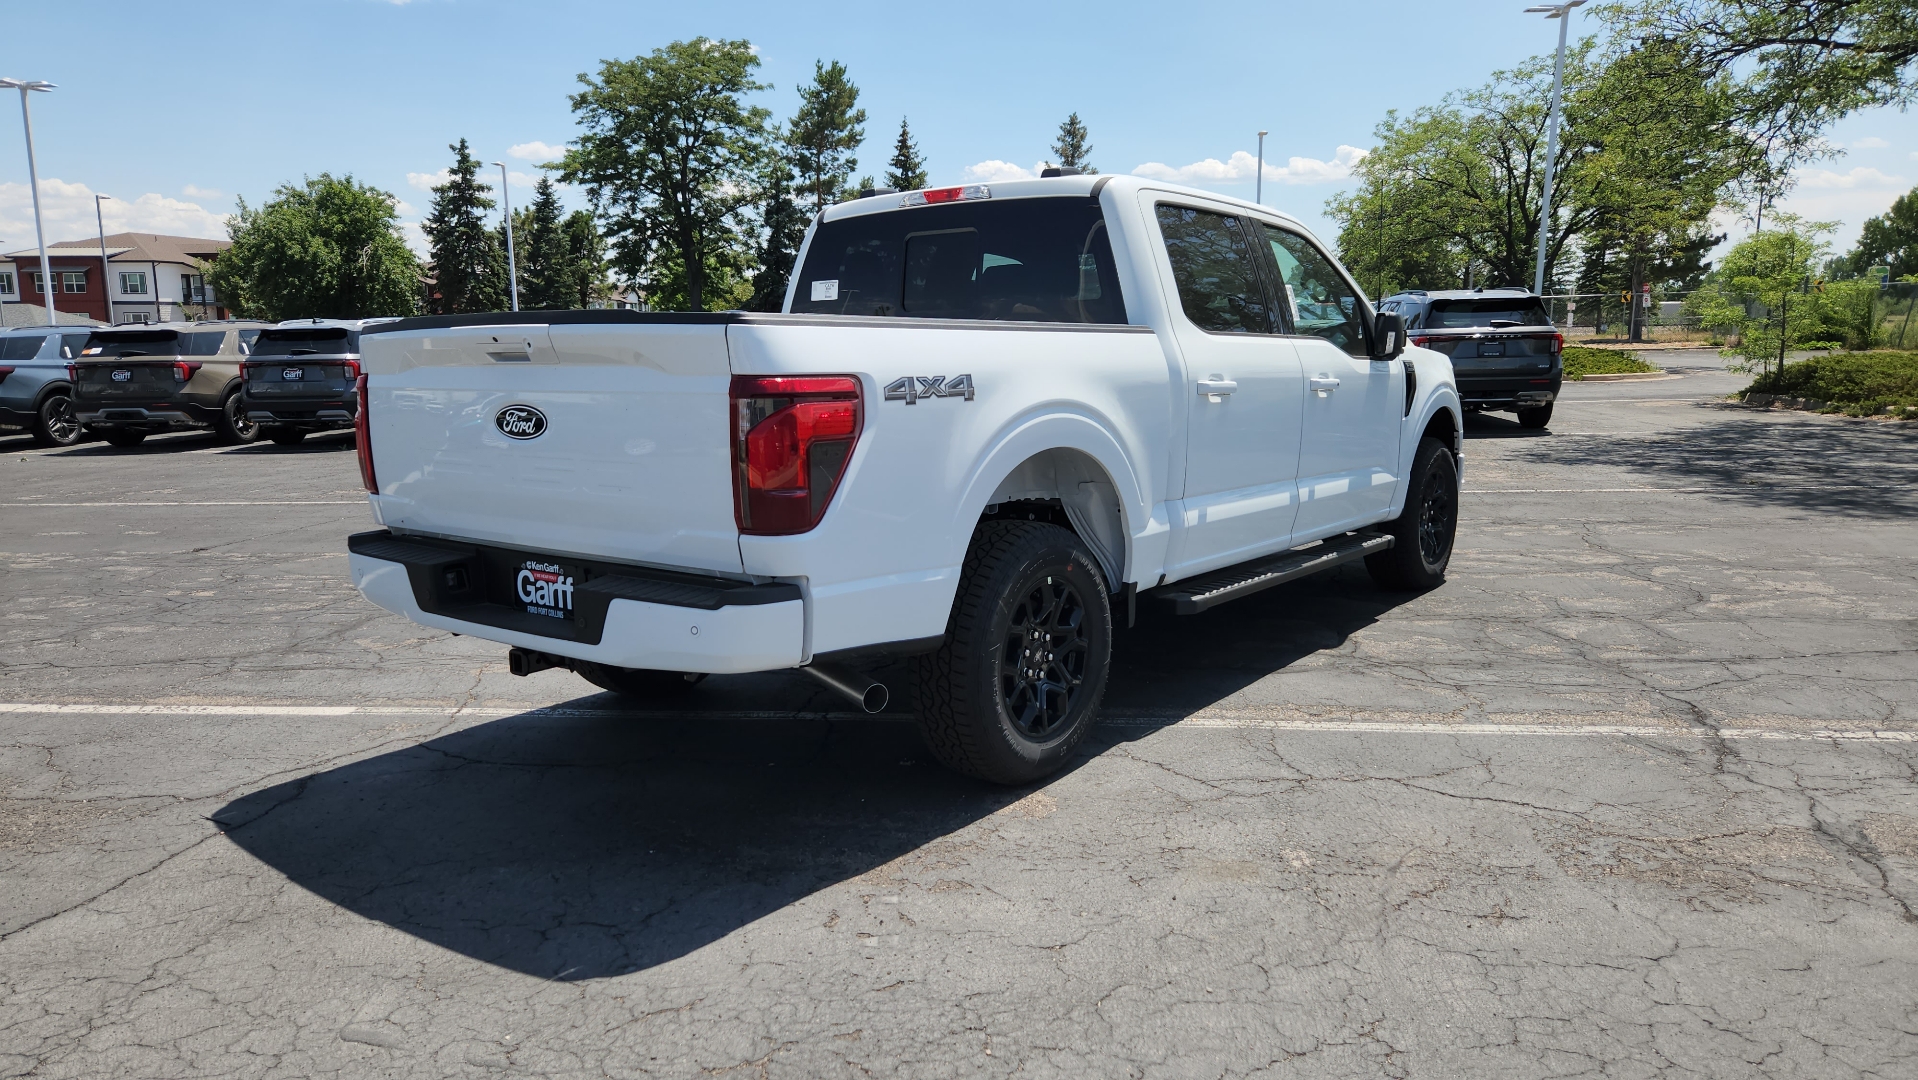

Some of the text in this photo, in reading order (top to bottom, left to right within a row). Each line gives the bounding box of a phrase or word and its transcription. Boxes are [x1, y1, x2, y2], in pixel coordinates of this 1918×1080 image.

[111, 371, 131, 380] Garff
[283, 370, 302, 378] Garff
[503, 410, 536, 434] Ford
[517, 569, 574, 610] Garff
